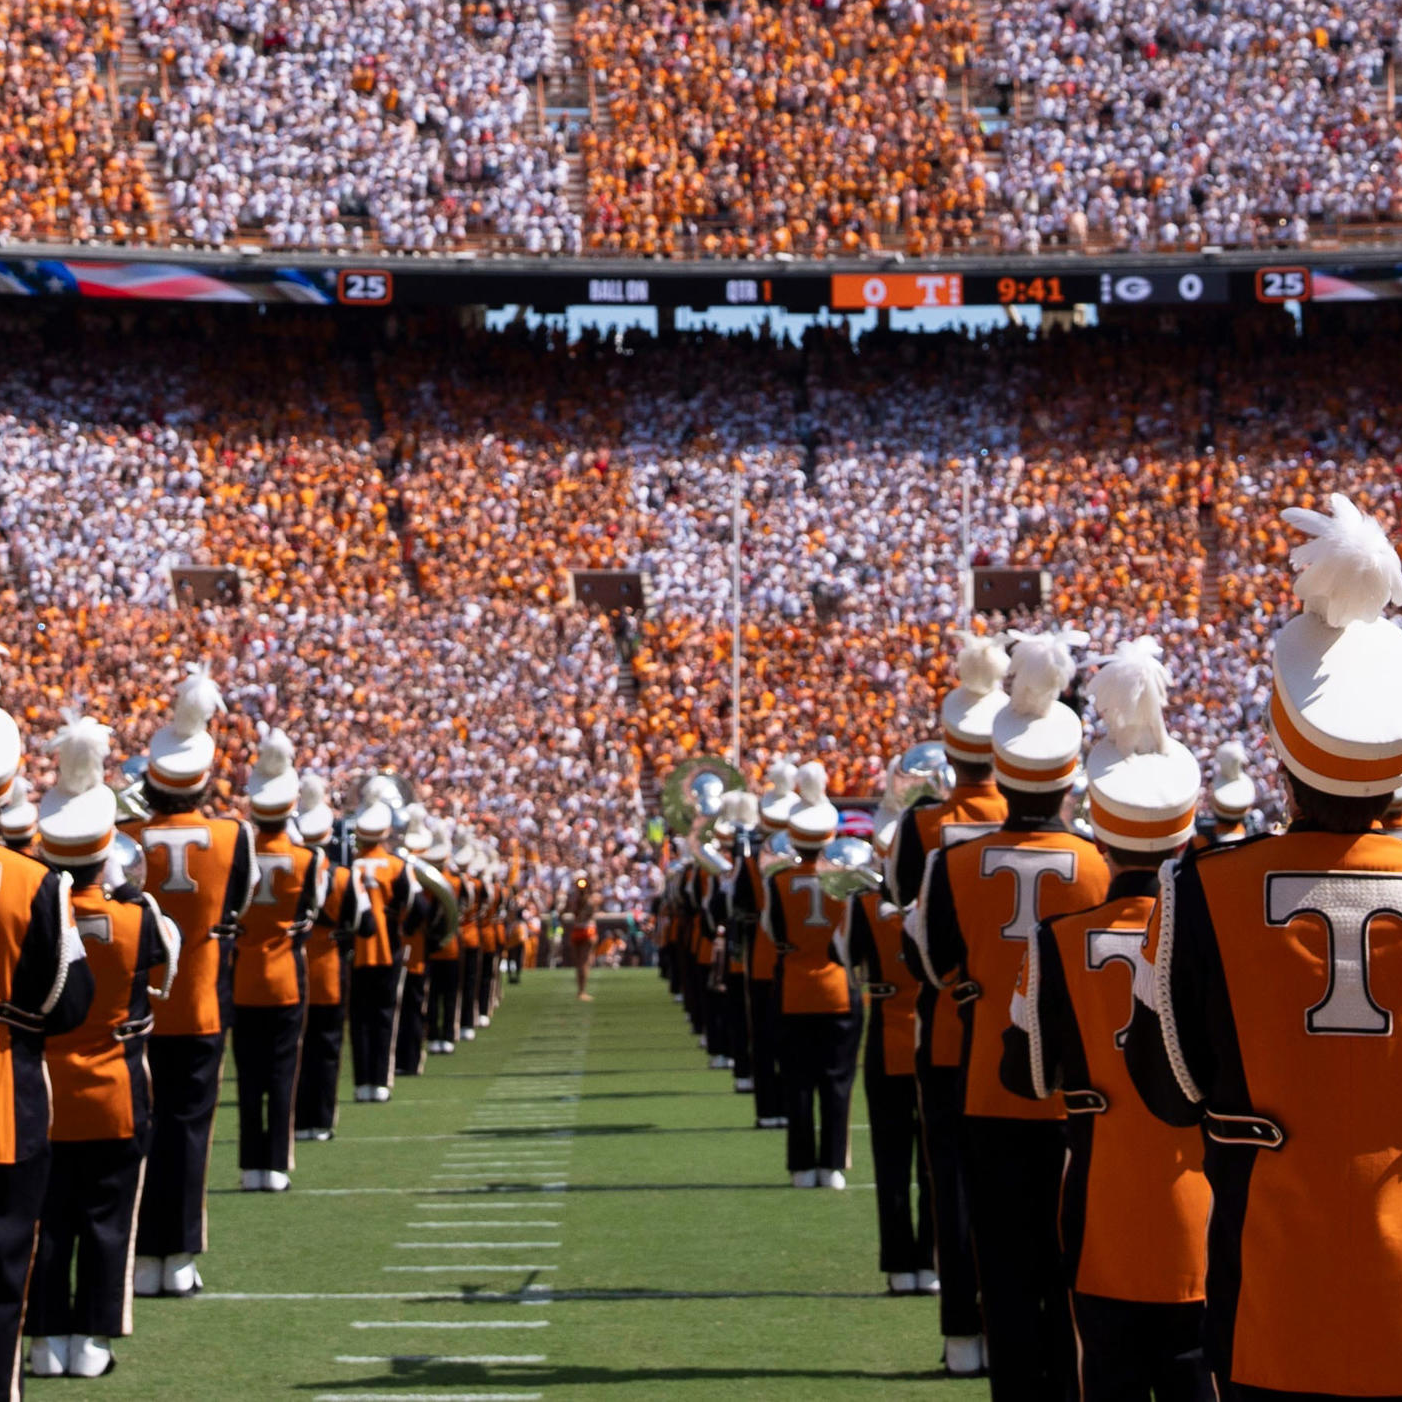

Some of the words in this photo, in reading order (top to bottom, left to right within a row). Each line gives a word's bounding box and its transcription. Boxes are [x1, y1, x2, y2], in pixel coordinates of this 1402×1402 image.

[346, 275, 386, 299] 25
[763, 280, 772, 302] 1
[862, 278, 887, 303] 0
[916, 276, 945, 305] T
[997, 277, 1065, 302] 9:41
[1115, 276, 1152, 300] G
[1178, 273, 1203, 301] 0
[1264, 272, 1304, 296] 25
[142, 827, 210, 893] T
[980, 845, 1078, 942] T
